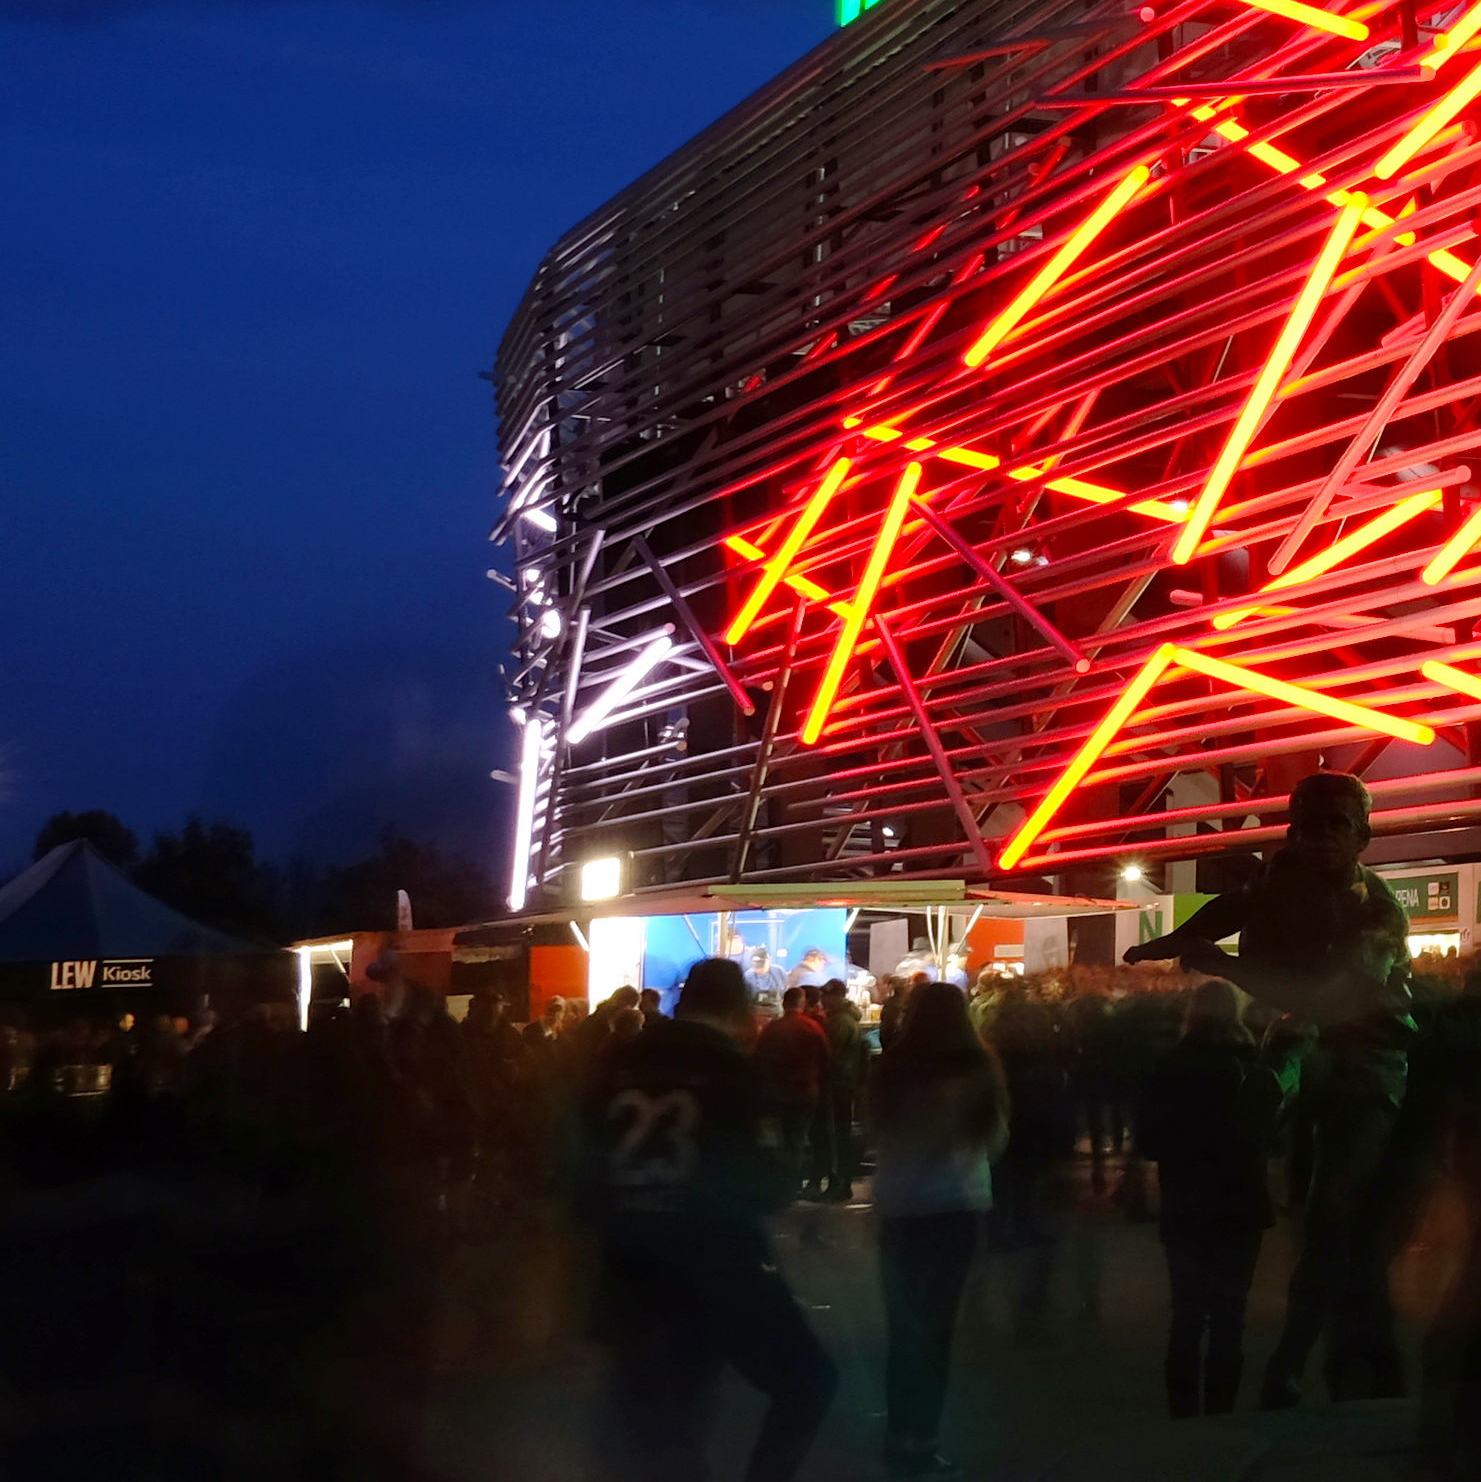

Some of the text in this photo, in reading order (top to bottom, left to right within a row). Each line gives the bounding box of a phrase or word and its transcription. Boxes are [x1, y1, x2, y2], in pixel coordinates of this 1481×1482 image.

[1392, 888, 1420, 908] RENA
[1138, 910, 1164, 946] N
[50, 960, 152, 990] LEW Kiosk
[607, 1087, 702, 1186] 23
